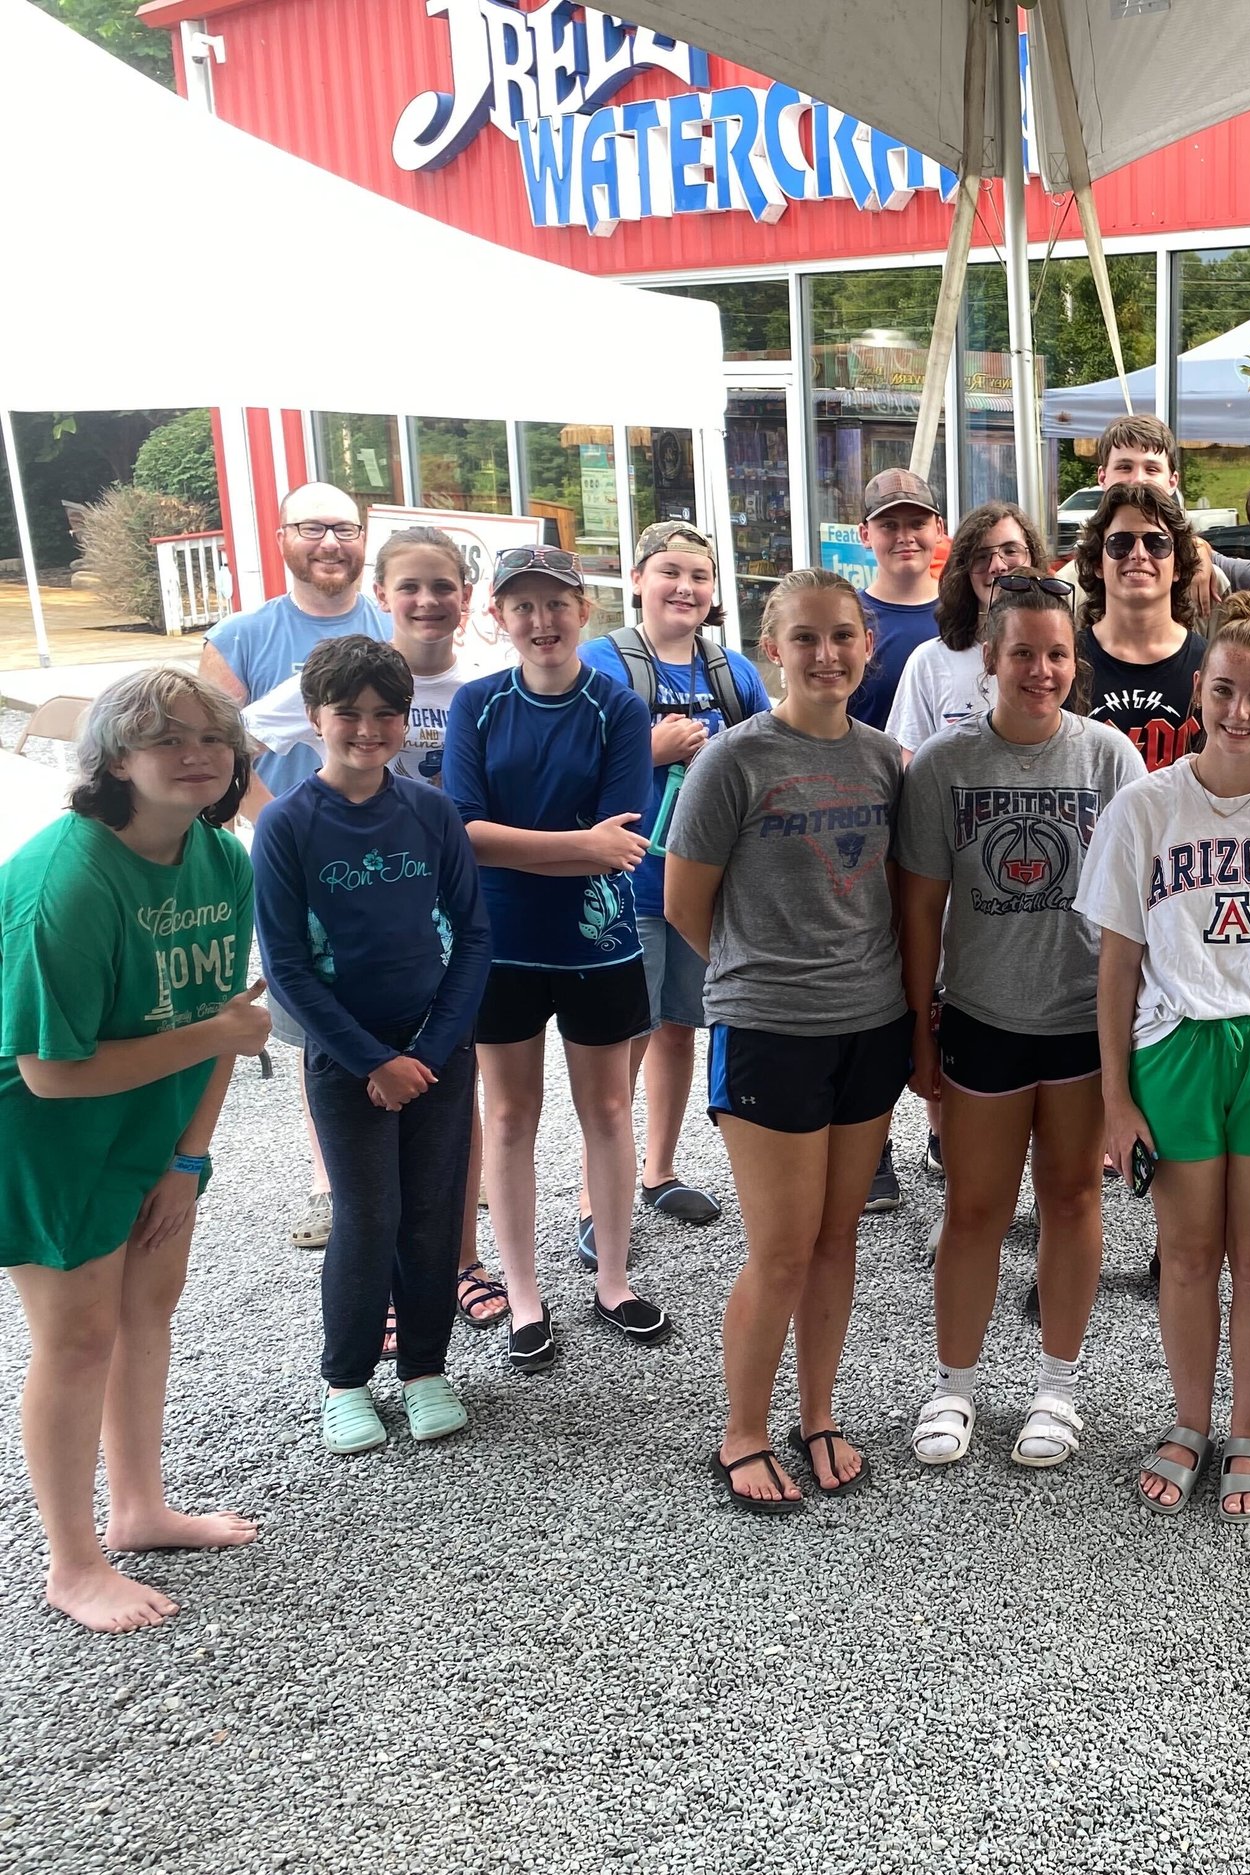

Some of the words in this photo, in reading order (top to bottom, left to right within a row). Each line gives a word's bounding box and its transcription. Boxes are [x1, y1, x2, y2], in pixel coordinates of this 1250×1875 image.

[1103, 689, 1163, 712] HIGH
[420, 729, 439, 741] AND
[319, 860, 373, 893] Ron
[971, 887, 1047, 916] Basketball
